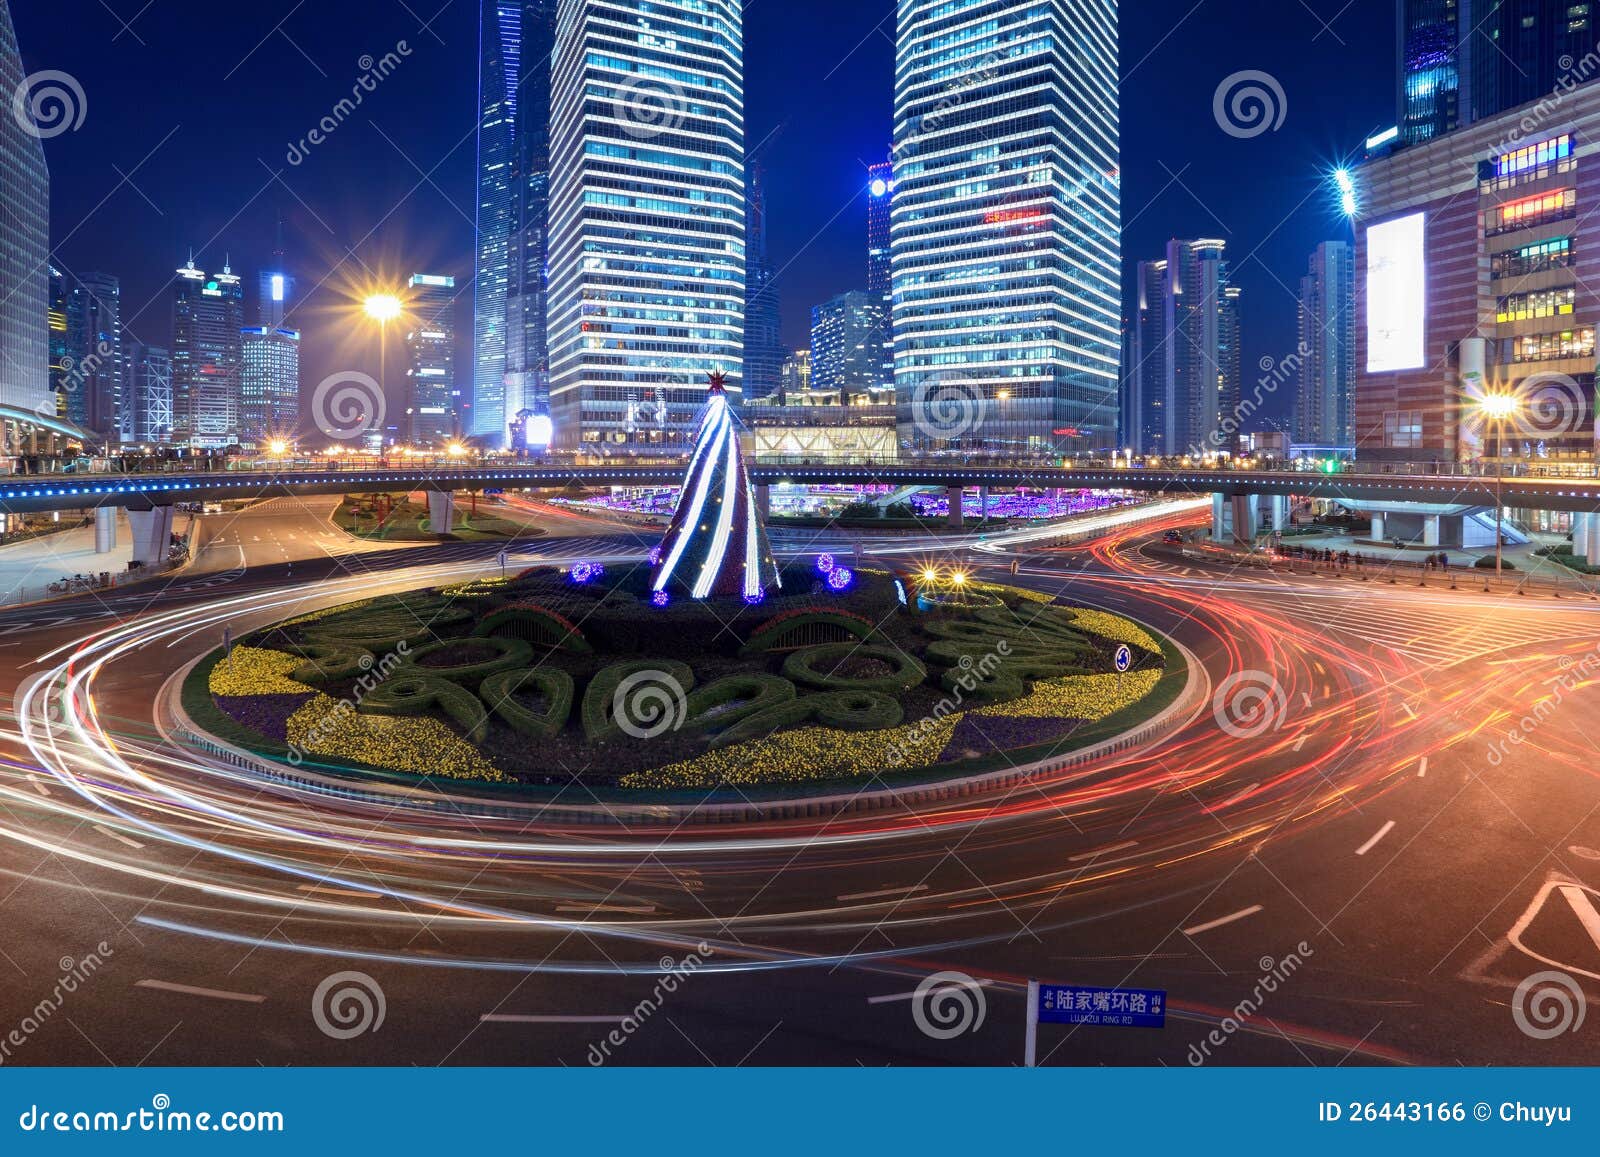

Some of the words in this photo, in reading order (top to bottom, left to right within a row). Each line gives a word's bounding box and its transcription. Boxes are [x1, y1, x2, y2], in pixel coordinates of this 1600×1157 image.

[1056, 990, 1147, 1013] 陆家嘴环路
[1070, 1014, 1100, 1024] LUJIAZUI
[1102, 1015, 1119, 1024] RING
[1122, 1016, 1133, 1024] RD
